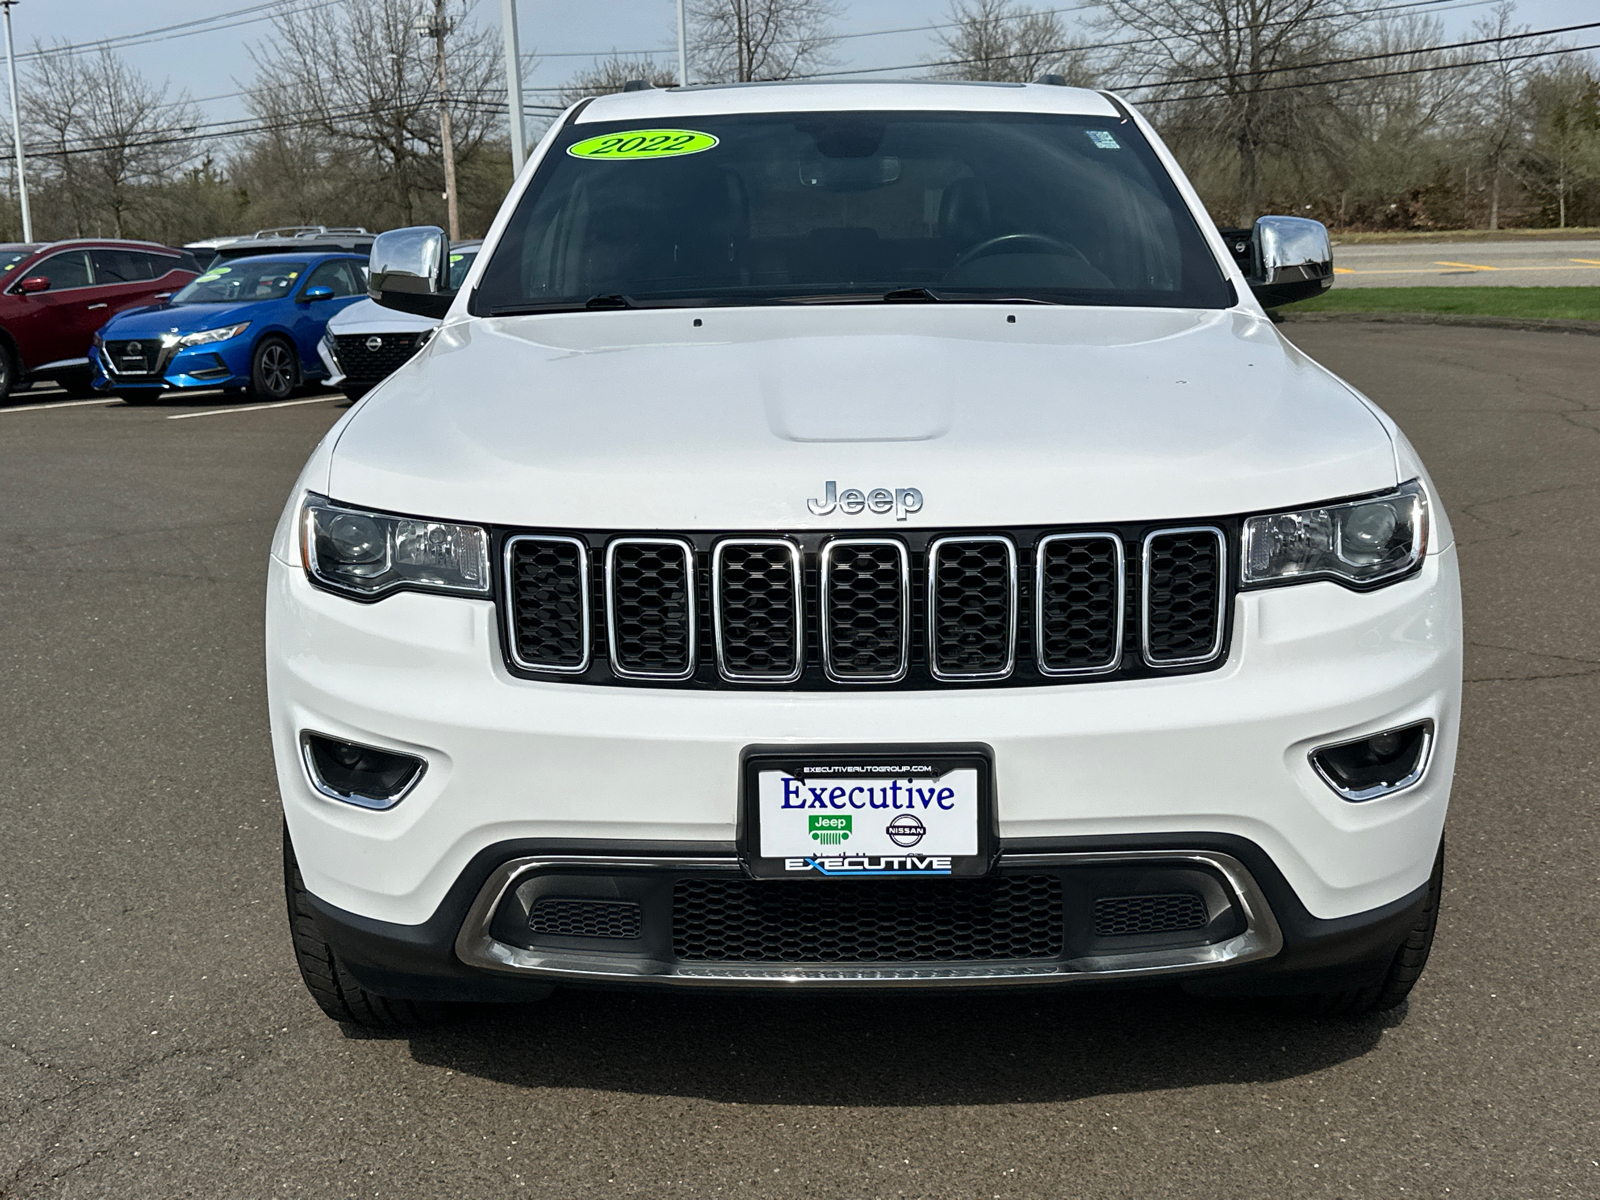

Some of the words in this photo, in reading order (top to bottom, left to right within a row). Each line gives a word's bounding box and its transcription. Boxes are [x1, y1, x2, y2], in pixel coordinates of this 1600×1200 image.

[588, 135, 696, 155] 2022
[806, 481, 923, 521] Jeep
[781, 777, 955, 810] Executive
[814, 817, 846, 829] Jeep
[784, 857, 952, 872] EXECUTIVE
